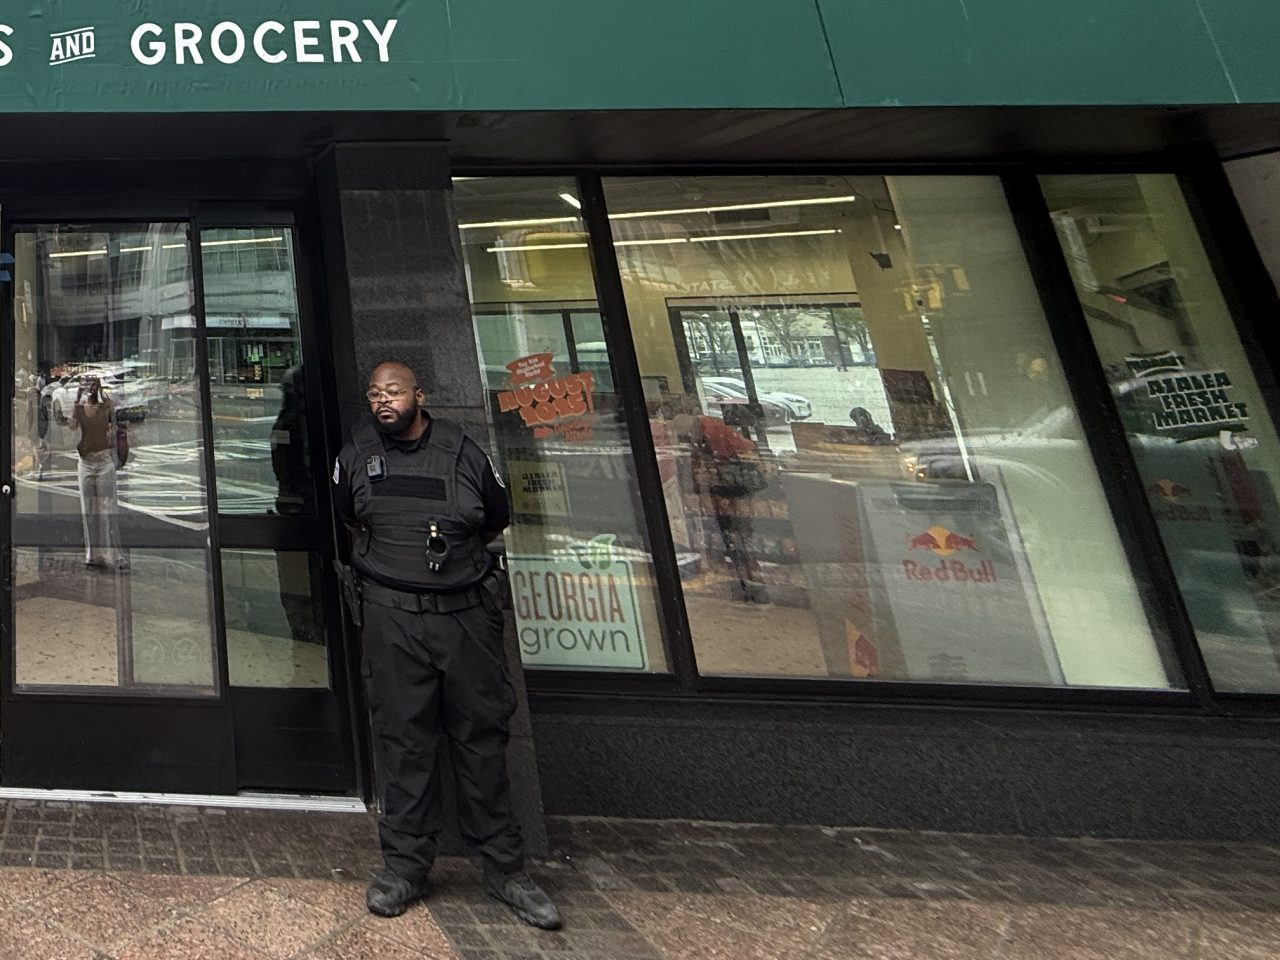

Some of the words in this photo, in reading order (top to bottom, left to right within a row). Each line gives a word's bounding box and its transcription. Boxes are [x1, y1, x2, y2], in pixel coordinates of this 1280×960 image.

[49, 30, 96, 61] AND
[130, 19, 398, 66] GROCERY
[497, 371, 595, 413] AUGUST
[1145, 370, 1233, 397] AZALEA
[1160, 388, 1232, 412] FRESH
[1153, 402, 1249, 429] MARKET
[512, 569, 625, 624] GEORGIA
[520, 626, 631, 656] grown
